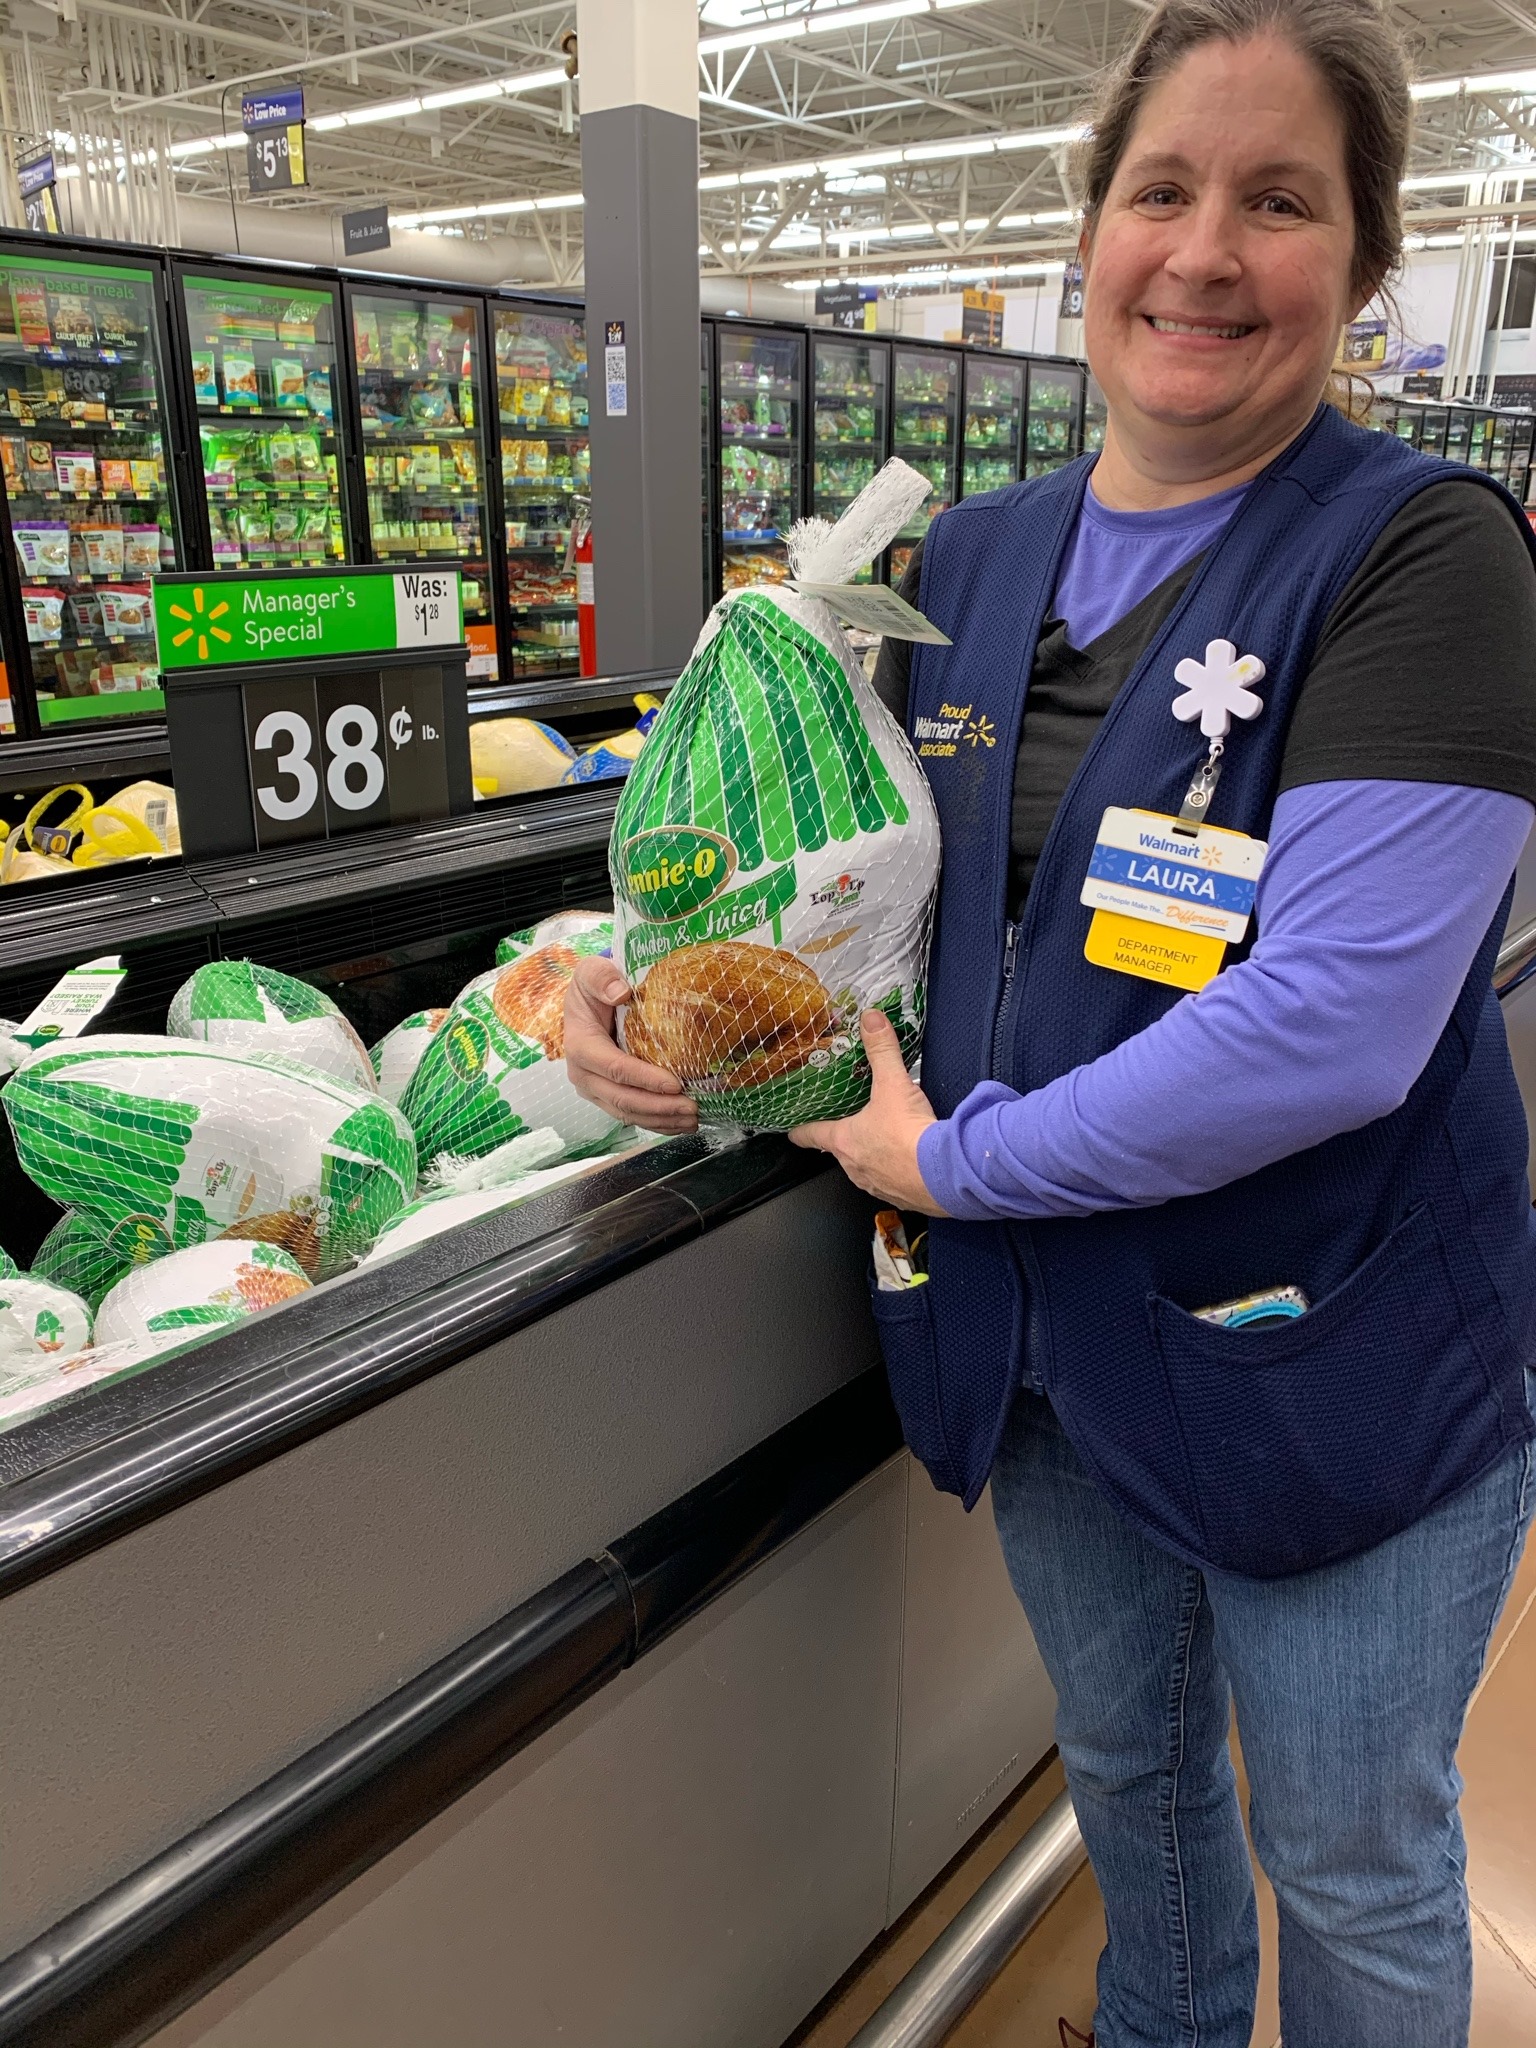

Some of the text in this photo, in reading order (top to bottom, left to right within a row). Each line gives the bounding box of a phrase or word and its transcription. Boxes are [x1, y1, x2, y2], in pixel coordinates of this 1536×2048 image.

[254, 104, 287, 120] Low Price
[350, 225, 383, 239] Fruit & Juice
[0, 271, 39, 287] Plant
[45, 277, 89, 295] based
[56, 331, 94, 341] CAULIFLOWER
[76, 340, 91, 348] MAC
[402, 575, 448, 599] Was:
[242, 585, 356, 616] Manager's
[245, 617, 323, 651] Special
[939, 703, 972, 719] Proud
[422, 724, 440, 741] lb.
[914, 716, 964, 740] Walmart
[1139, 833, 1200, 859] Walmart
[1127, 860, 1216, 900] LAURA
[1096, 892, 1108, 900] Our
[1109, 895, 1130, 906] People
[1131, 901, 1148, 911] Make
[1165, 905, 1229, 927] Difference
[629, 897, 768, 961] Tender & Juicy
[1117, 937, 1198, 965] DEPARTMENT
[1114, 952, 1172, 975] MANAGER
[205, 1180, 220, 1198] Pop
